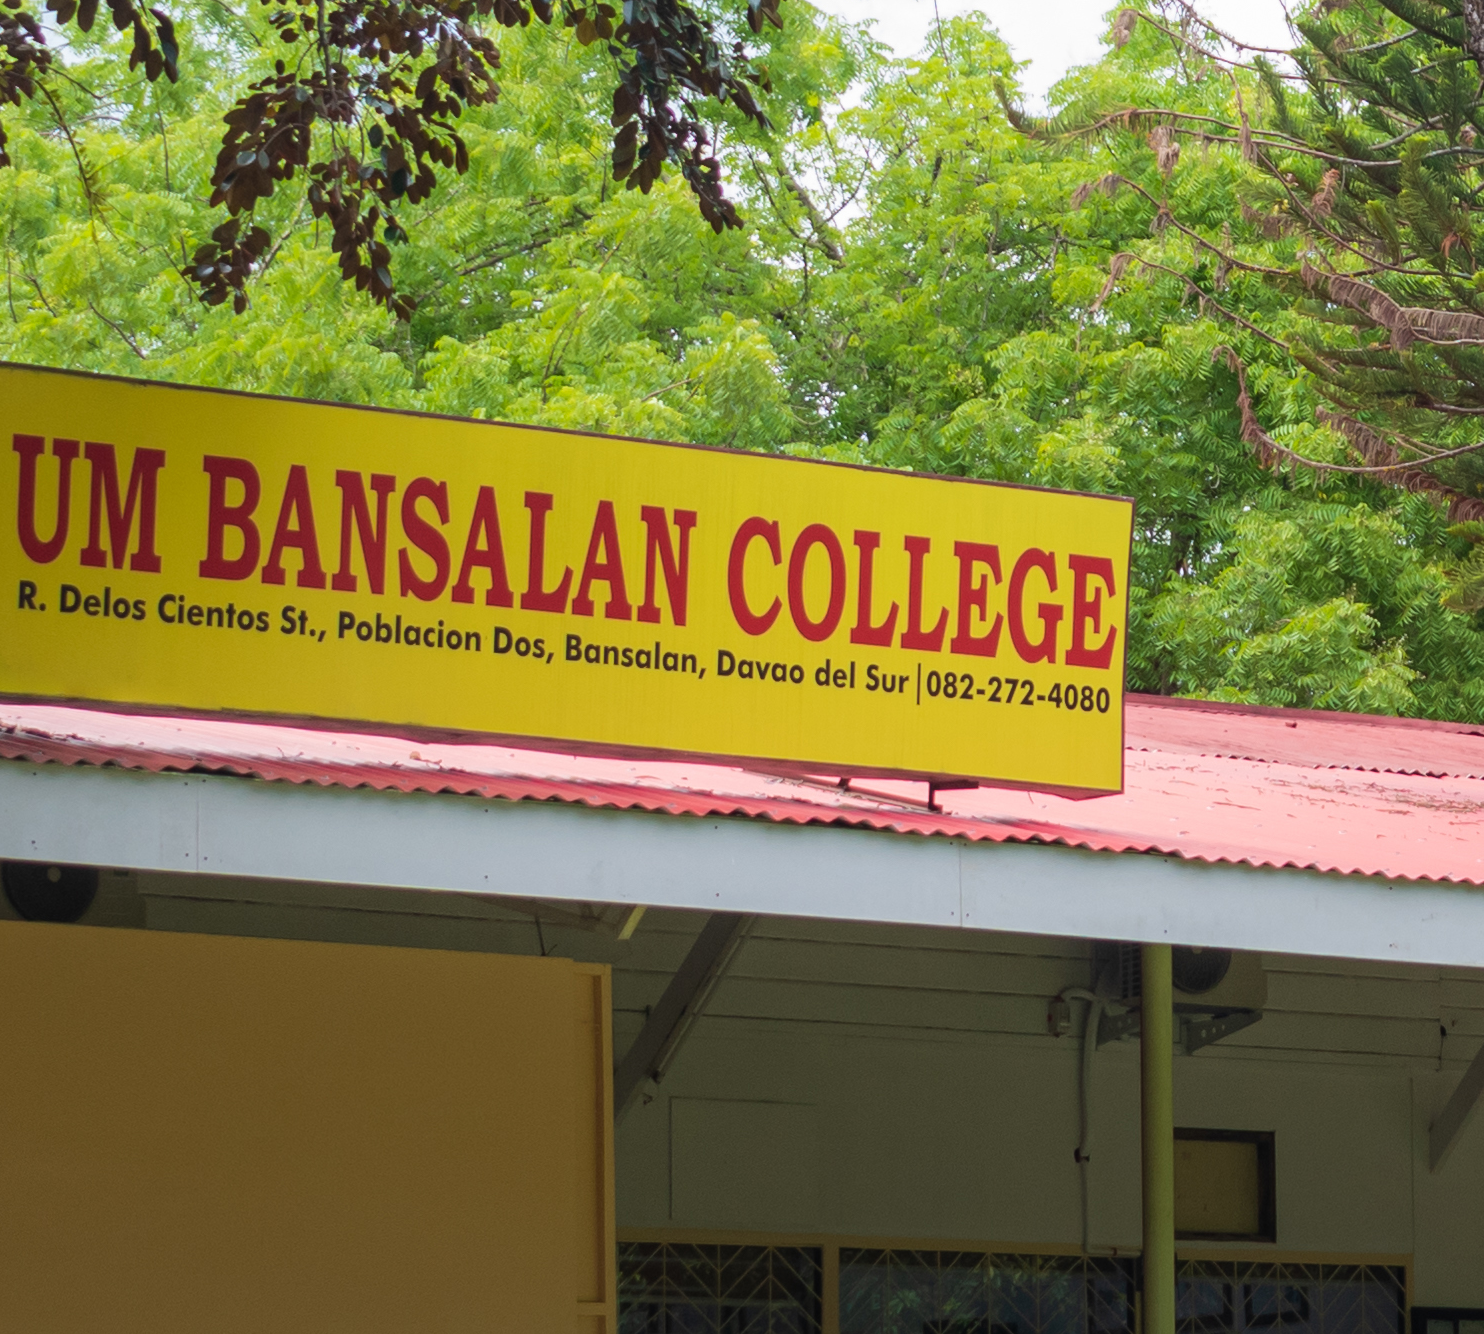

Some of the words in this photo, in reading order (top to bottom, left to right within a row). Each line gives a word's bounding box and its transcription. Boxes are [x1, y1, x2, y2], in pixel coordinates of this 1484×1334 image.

[14, 435, 164, 572] UM
[200, 457, 696, 625] BANSALAN
[729, 518, 1117, 669] COLLEGE
[18, 580, 46, 611] R.
[60, 584, 146, 620] Delos
[158, 593, 269, 632] Cientos
[281, 605, 326, 641] St.,
[338, 612, 481, 652] Poblacion
[493, 627, 554, 664] Dos,
[565, 634, 706, 678] Bansalan,
[717, 650, 804, 683] Davao
[816, 660, 855, 688] del
